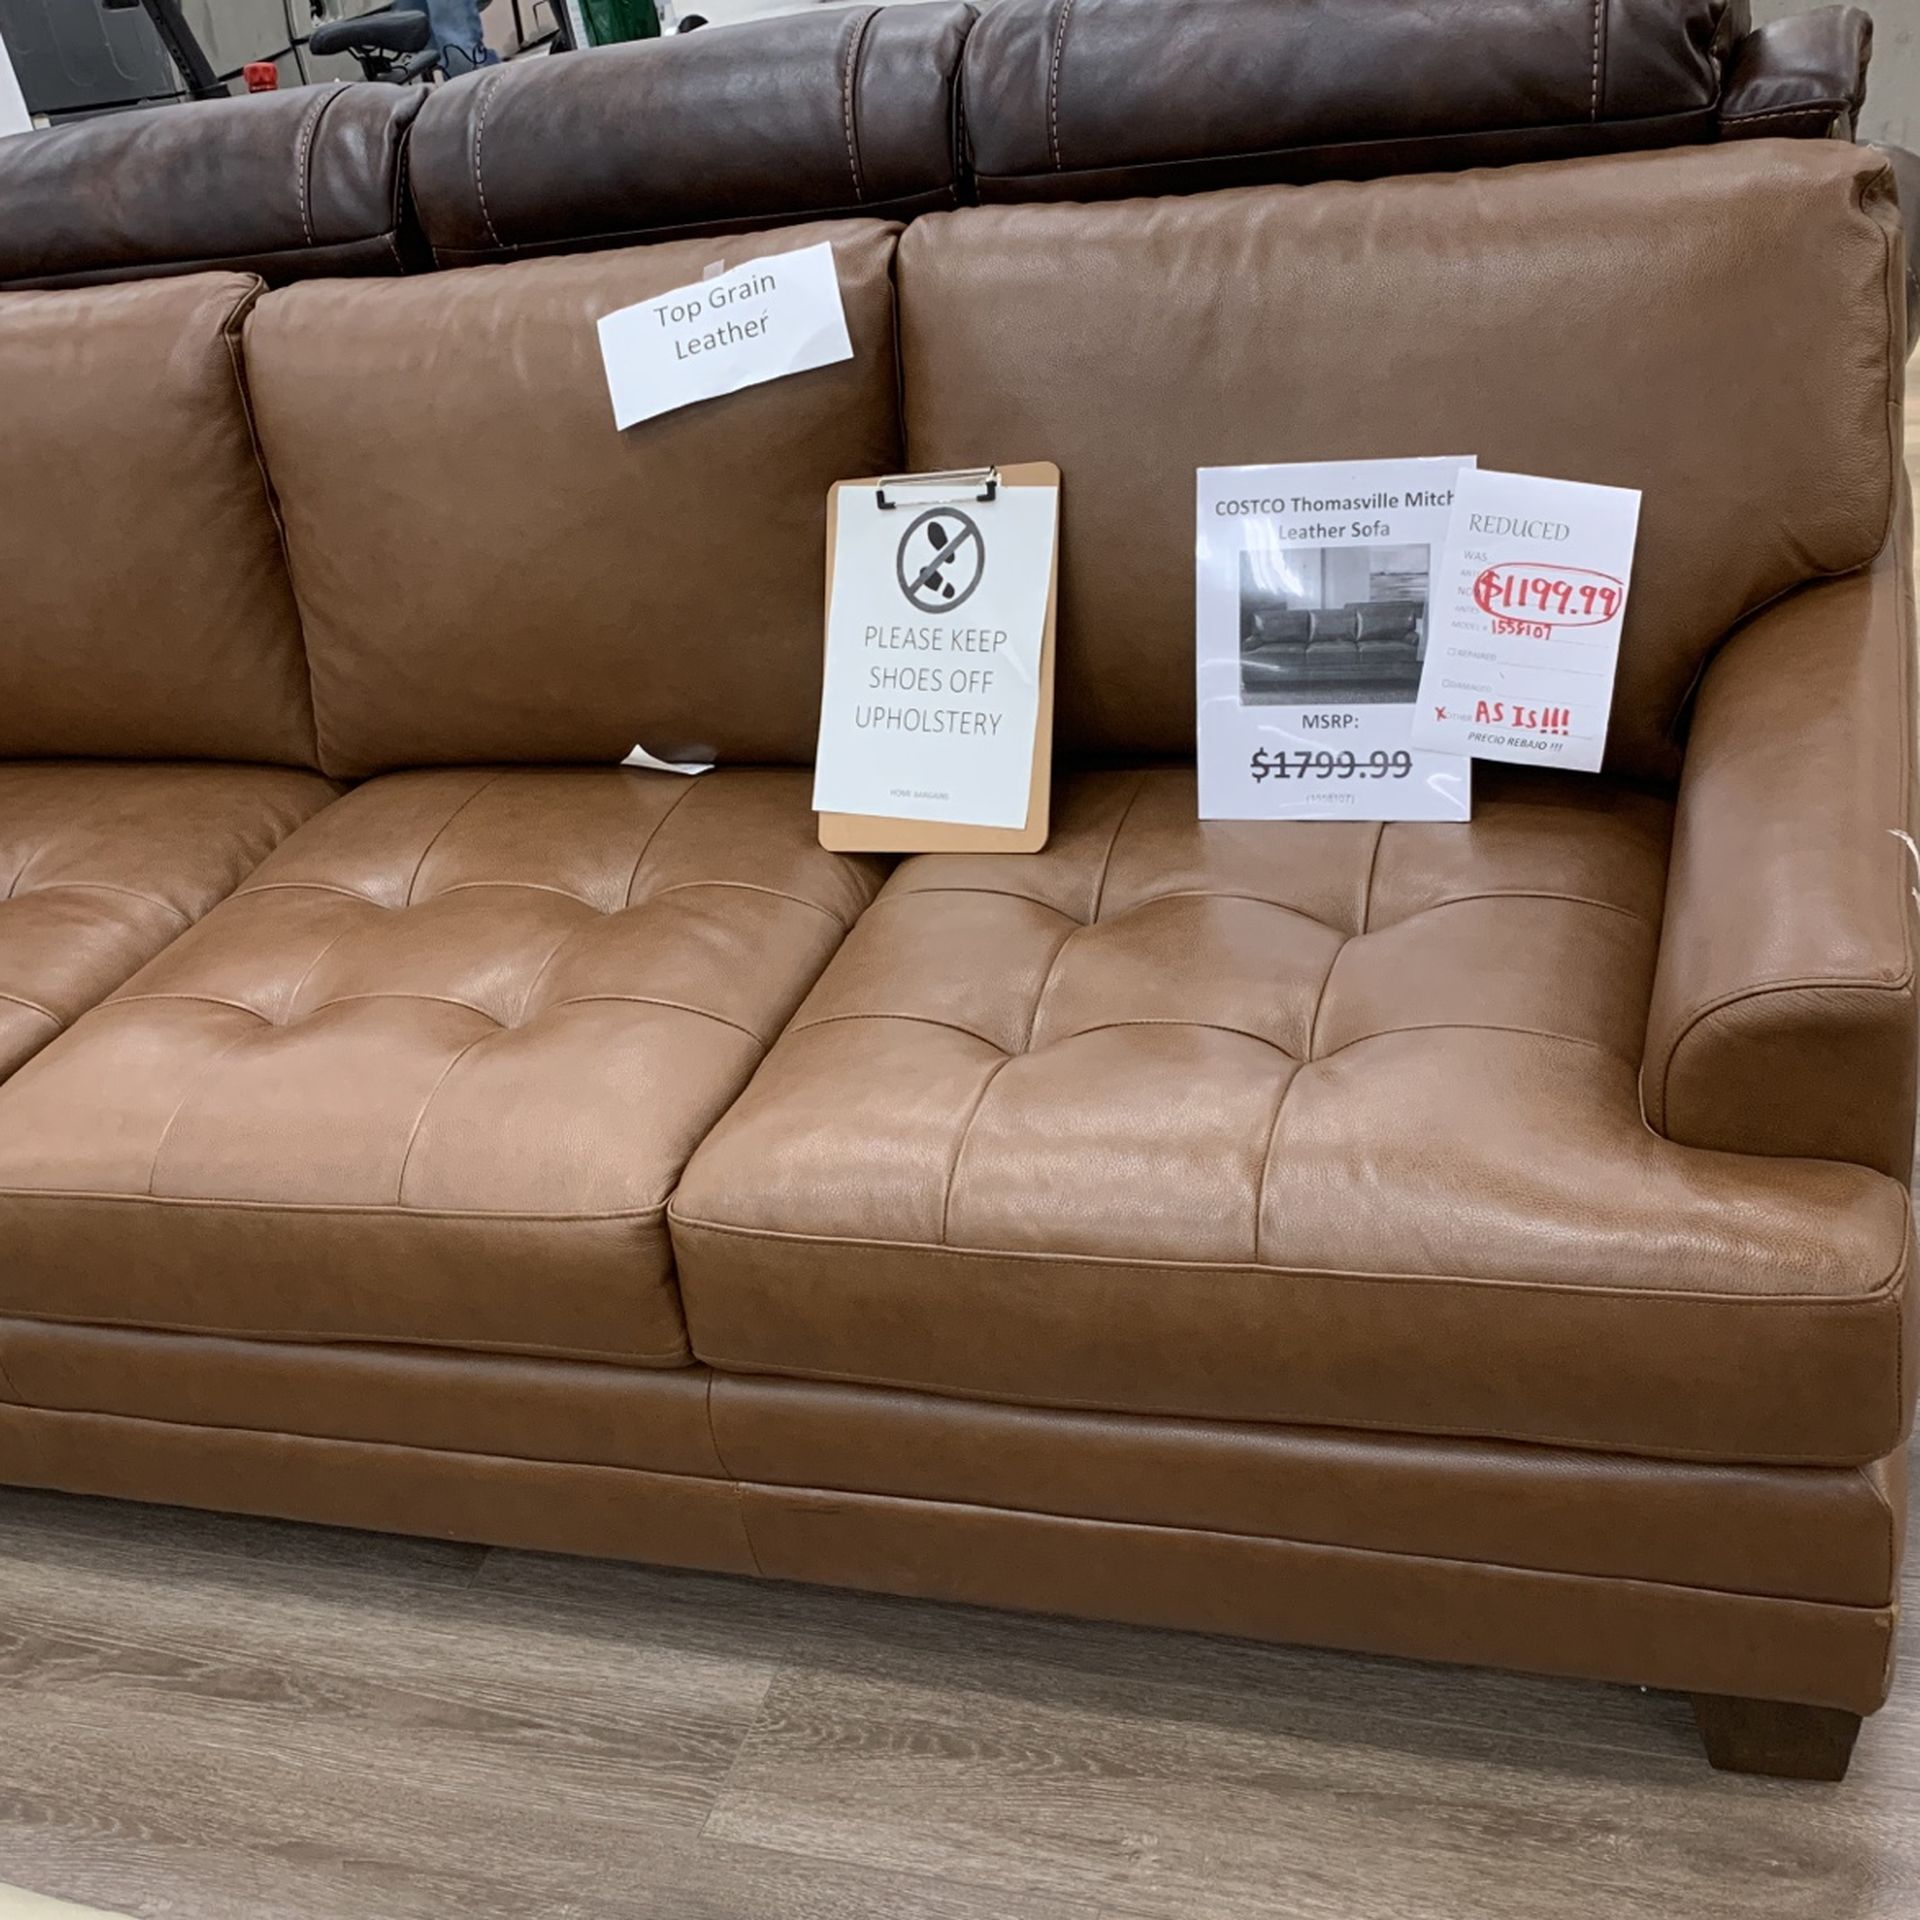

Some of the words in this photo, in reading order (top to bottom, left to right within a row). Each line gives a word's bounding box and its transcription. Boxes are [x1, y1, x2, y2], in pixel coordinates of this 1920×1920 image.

[653, 300, 702, 327] Top
[708, 274, 776, 309] Grain
[674, 314, 769, 360] Leather
[1215, 498, 1286, 516] COSTCO
[1291, 493, 1399, 513] Thomasville
[1278, 522, 1346, 540] Leather
[1351, 520, 1391, 538] Sofa
[1468, 513, 1570, 541] REDUCED
[1463, 550, 1488, 562] WAS
[1480, 569, 1616, 616] $1199.99
[864, 625, 943, 652] PLEASE
[950, 628, 1008, 653] KEEP
[868, 666, 943, 692] SHOES
[949, 668, 994, 694] OFF
[855, 705, 1003, 736] UPHOLSTERY
[1302, 713, 1359, 730] MSRP:
[1474, 700, 1504, 724] AS
[1467, 732, 1506, 746] PRECIO
[1506, 737, 1547, 751] REBAJO
[1250, 747, 1413, 784] $1799.99
